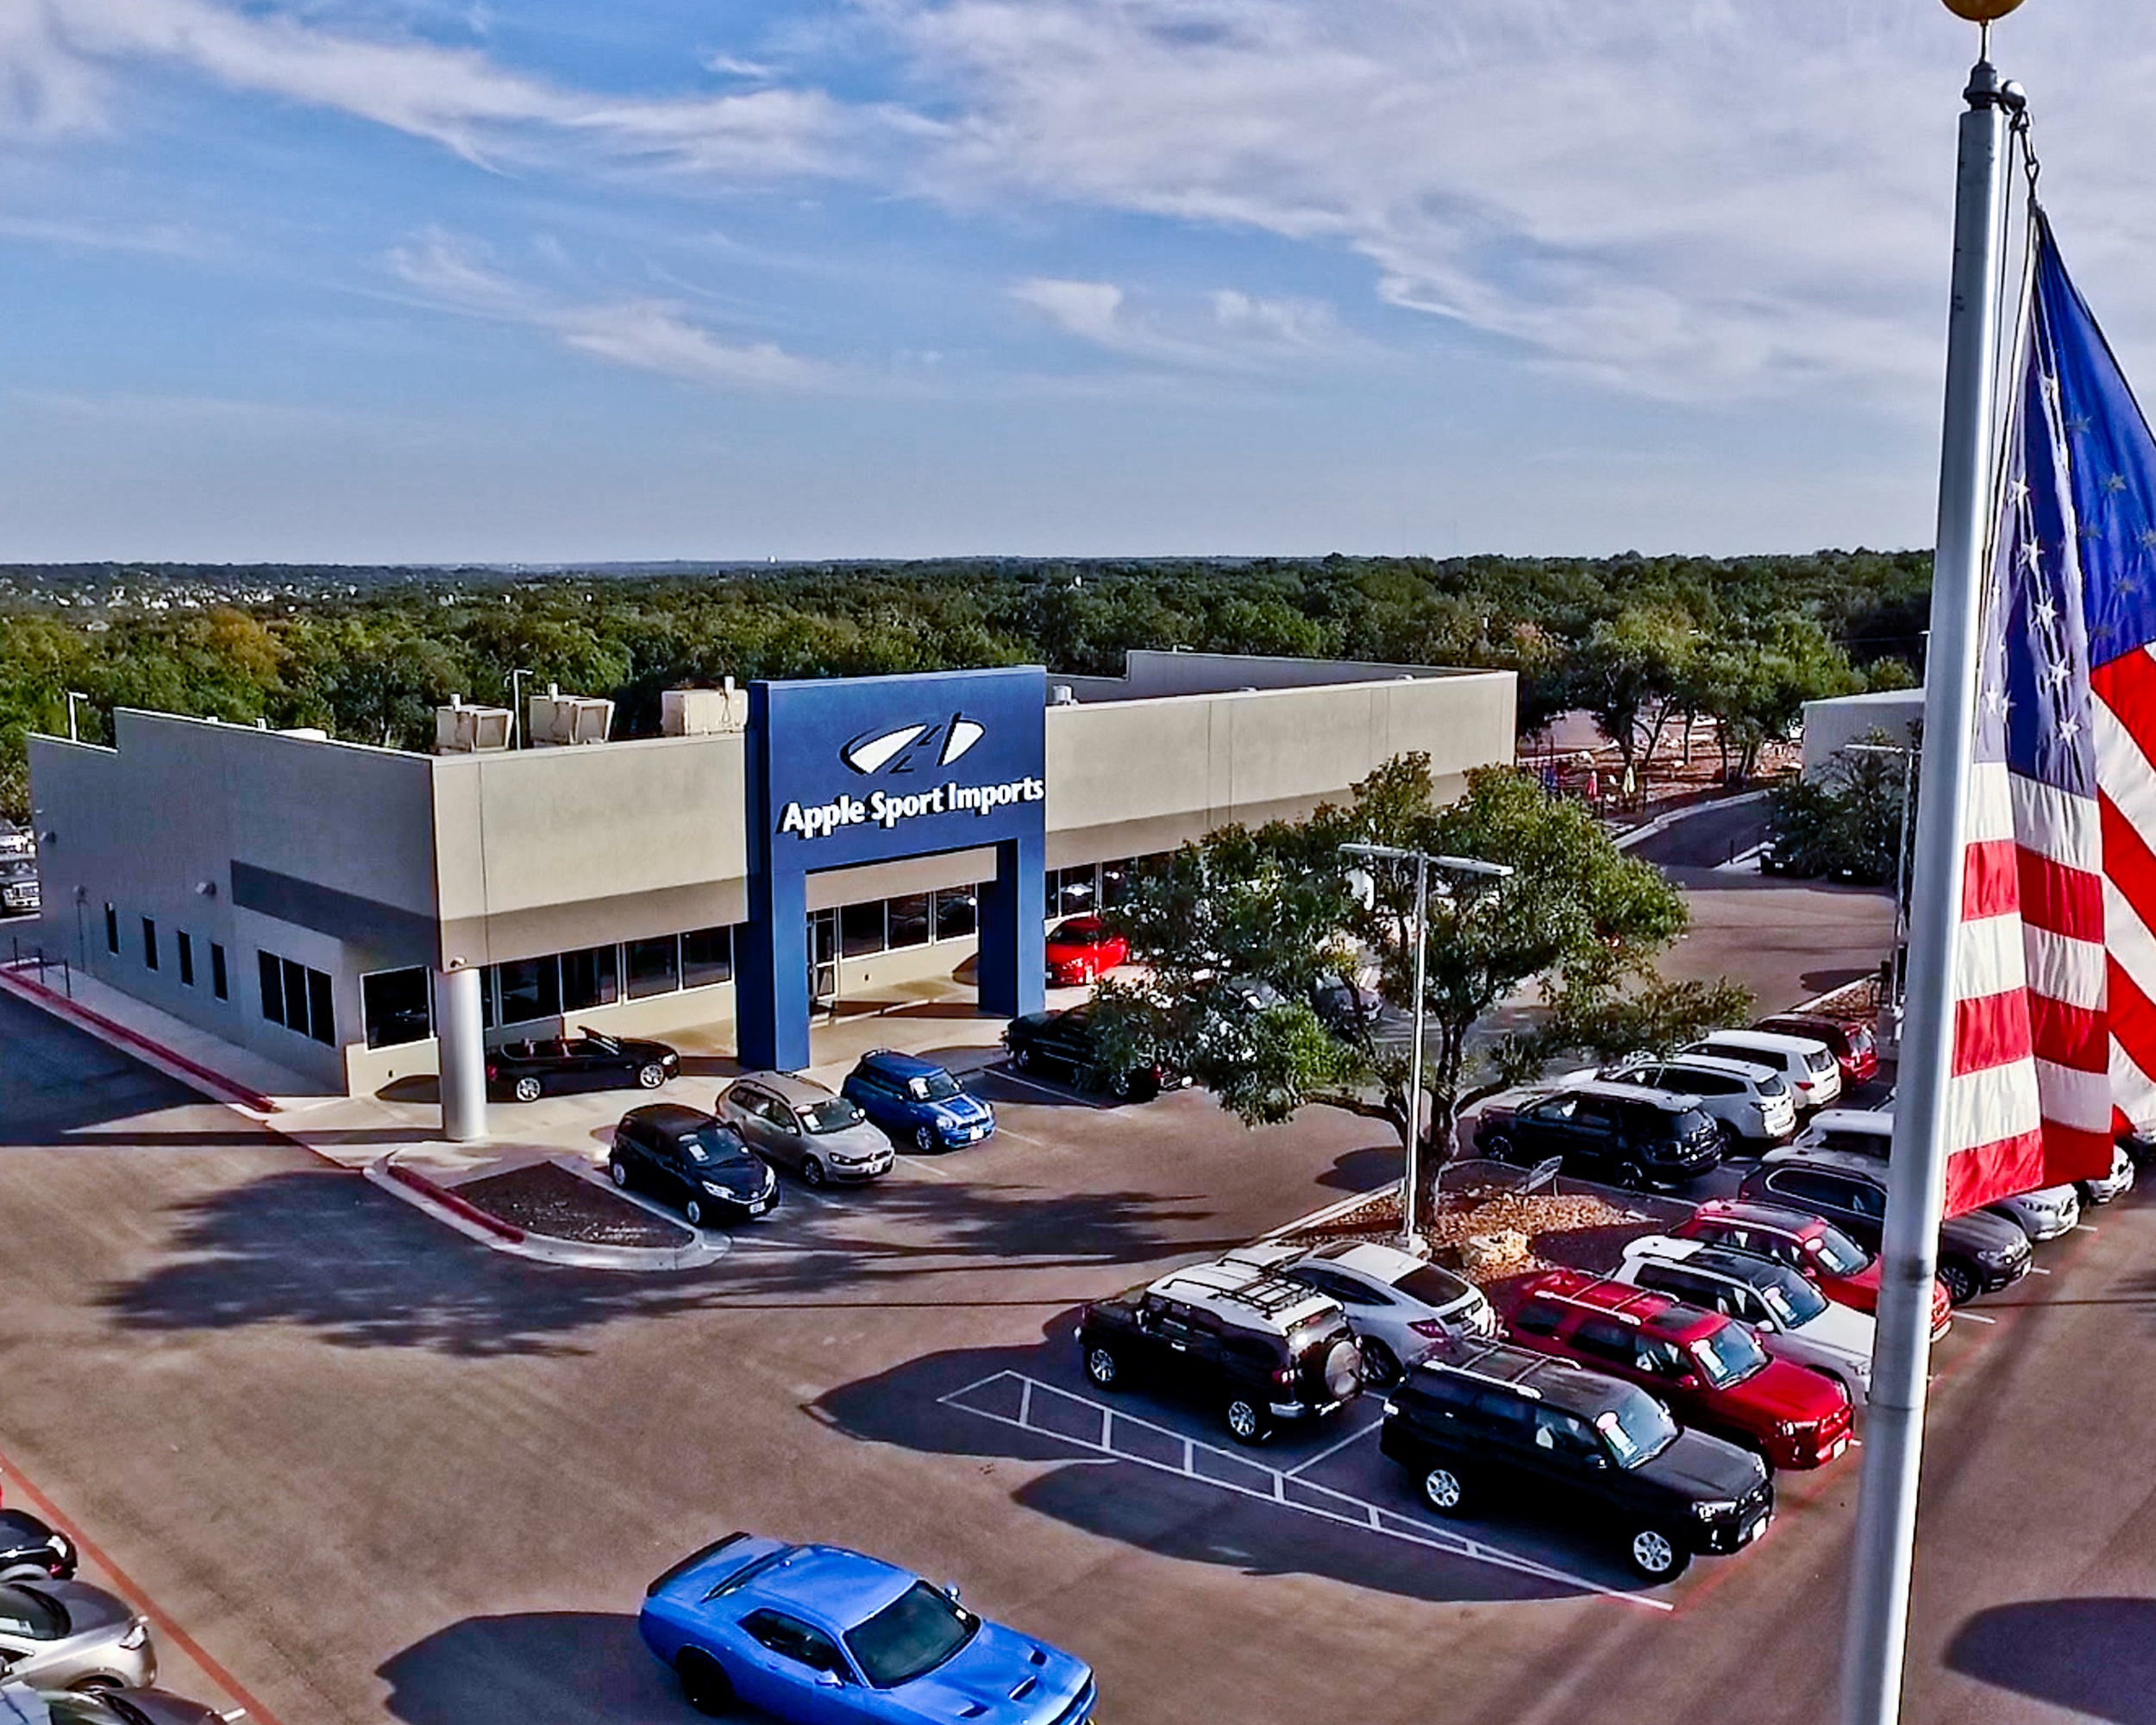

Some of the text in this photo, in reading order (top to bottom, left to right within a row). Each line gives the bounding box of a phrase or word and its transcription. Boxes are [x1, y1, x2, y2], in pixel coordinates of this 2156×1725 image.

[782, 777, 1044, 838] Apple Sport Imports
